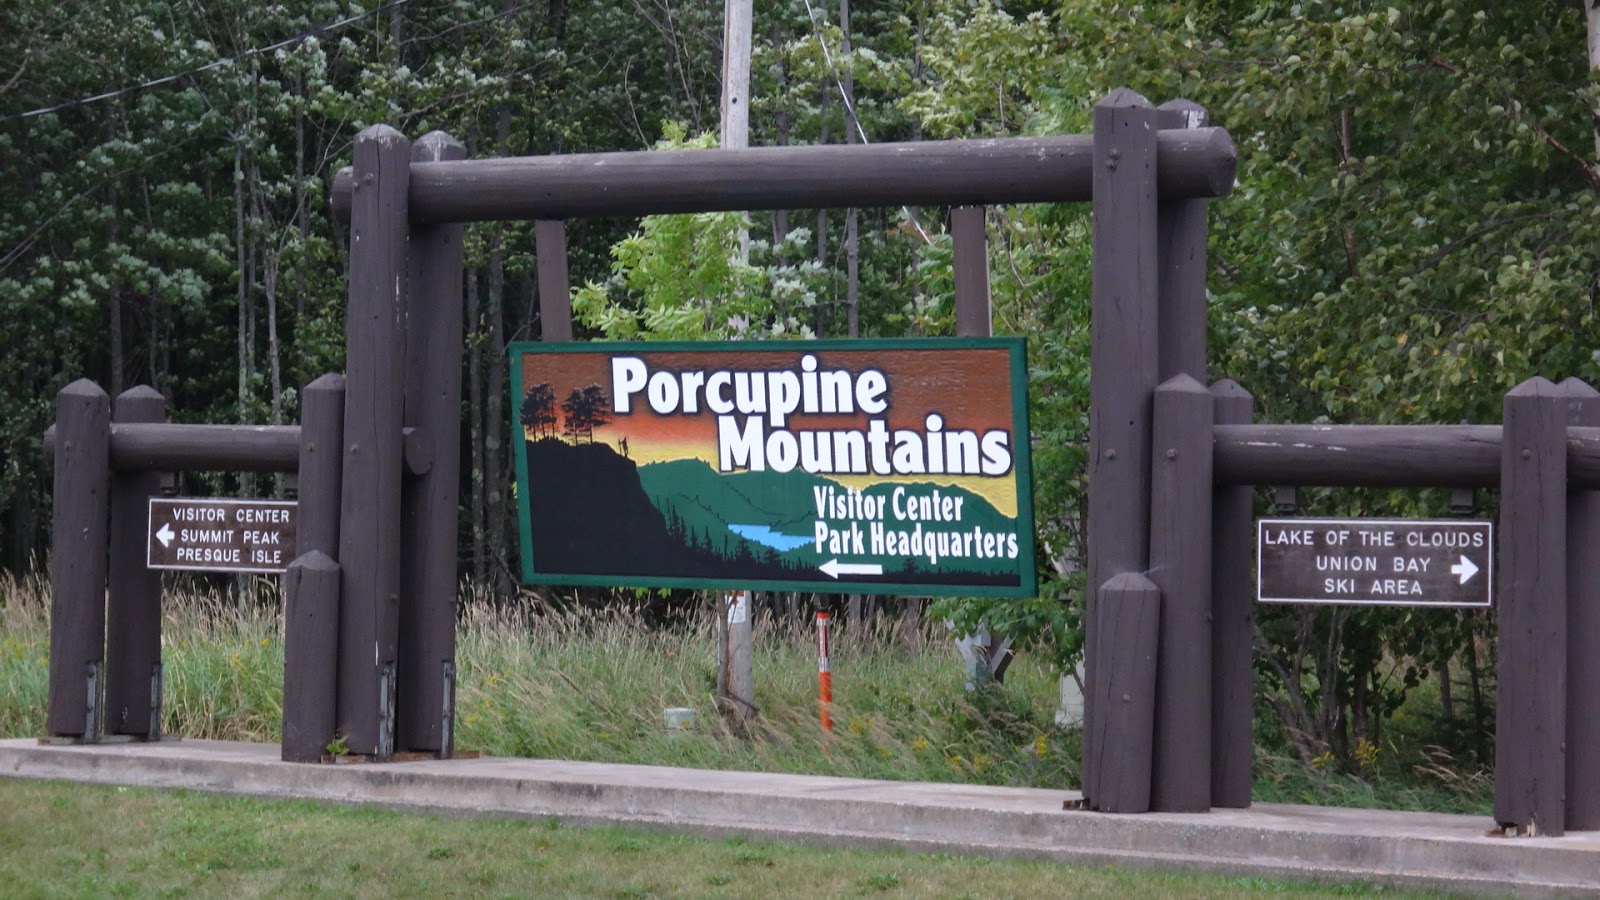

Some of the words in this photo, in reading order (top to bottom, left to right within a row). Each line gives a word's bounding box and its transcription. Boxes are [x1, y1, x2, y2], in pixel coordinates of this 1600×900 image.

[612, 354, 888, 427] Porcupine
[718, 414, 1012, 476] Mountains
[814, 485, 885, 521] Visitor
[893, 487, 963, 522] Center
[173, 508, 225, 521] VISITOR
[236, 509, 290, 523] CENTER
[181, 529, 234, 543] SUMMIT
[243, 531, 279, 544] PEAK
[814, 521, 864, 555] Park
[871, 523, 1019, 564] Headquarters
[1265, 530, 1314, 545] LAKE
[1326, 530, 1350, 545] OF
[1358, 531, 1395, 546] THE
[1406, 532, 1484, 547] CLOUDS
[177, 548, 240, 562] PRESQUE
[251, 550, 281, 563] ISLE
[1316, 556, 1377, 571] UNION
[1393, 557, 1431, 572] BAY
[1324, 579, 1355, 593] SKI
[1370, 580, 1423, 595] AREA
